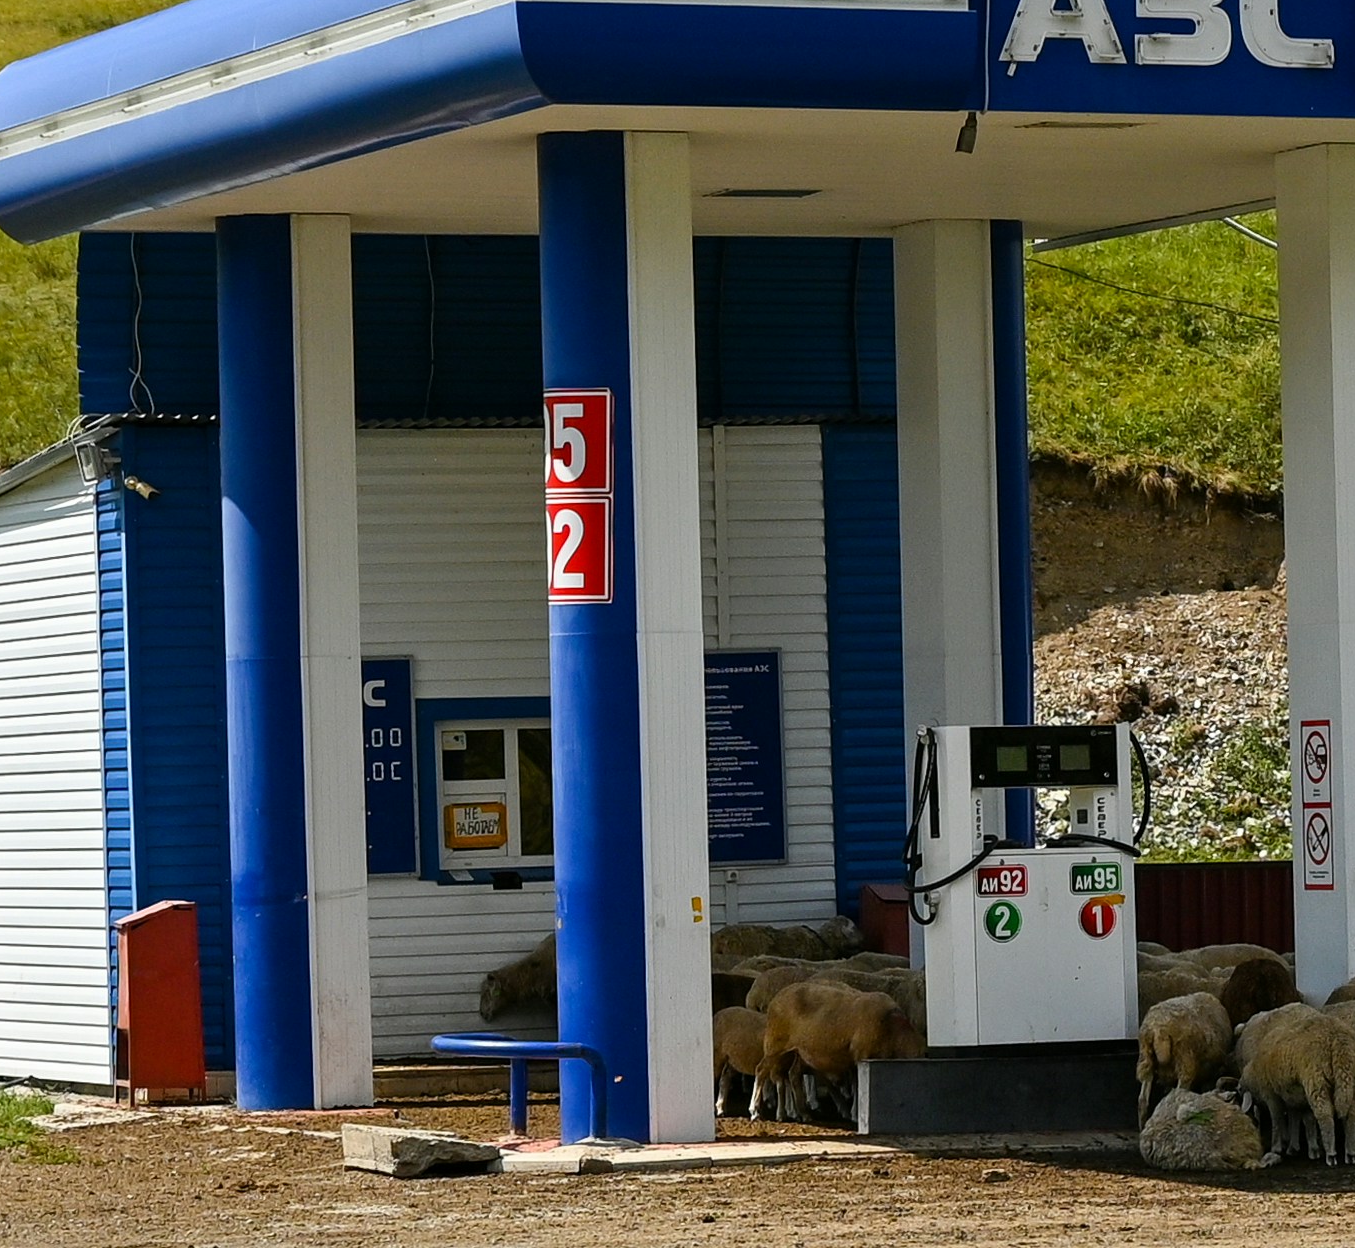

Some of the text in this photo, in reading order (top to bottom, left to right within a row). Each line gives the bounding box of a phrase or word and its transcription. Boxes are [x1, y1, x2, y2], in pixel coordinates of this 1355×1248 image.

[545, 403, 586, 483] 5
[546, 509, 585, 590] 2
[464, 807, 479, 820] НЕ
[995, 905, 1011, 937] 2
[1092, 905, 1103, 934] 1
